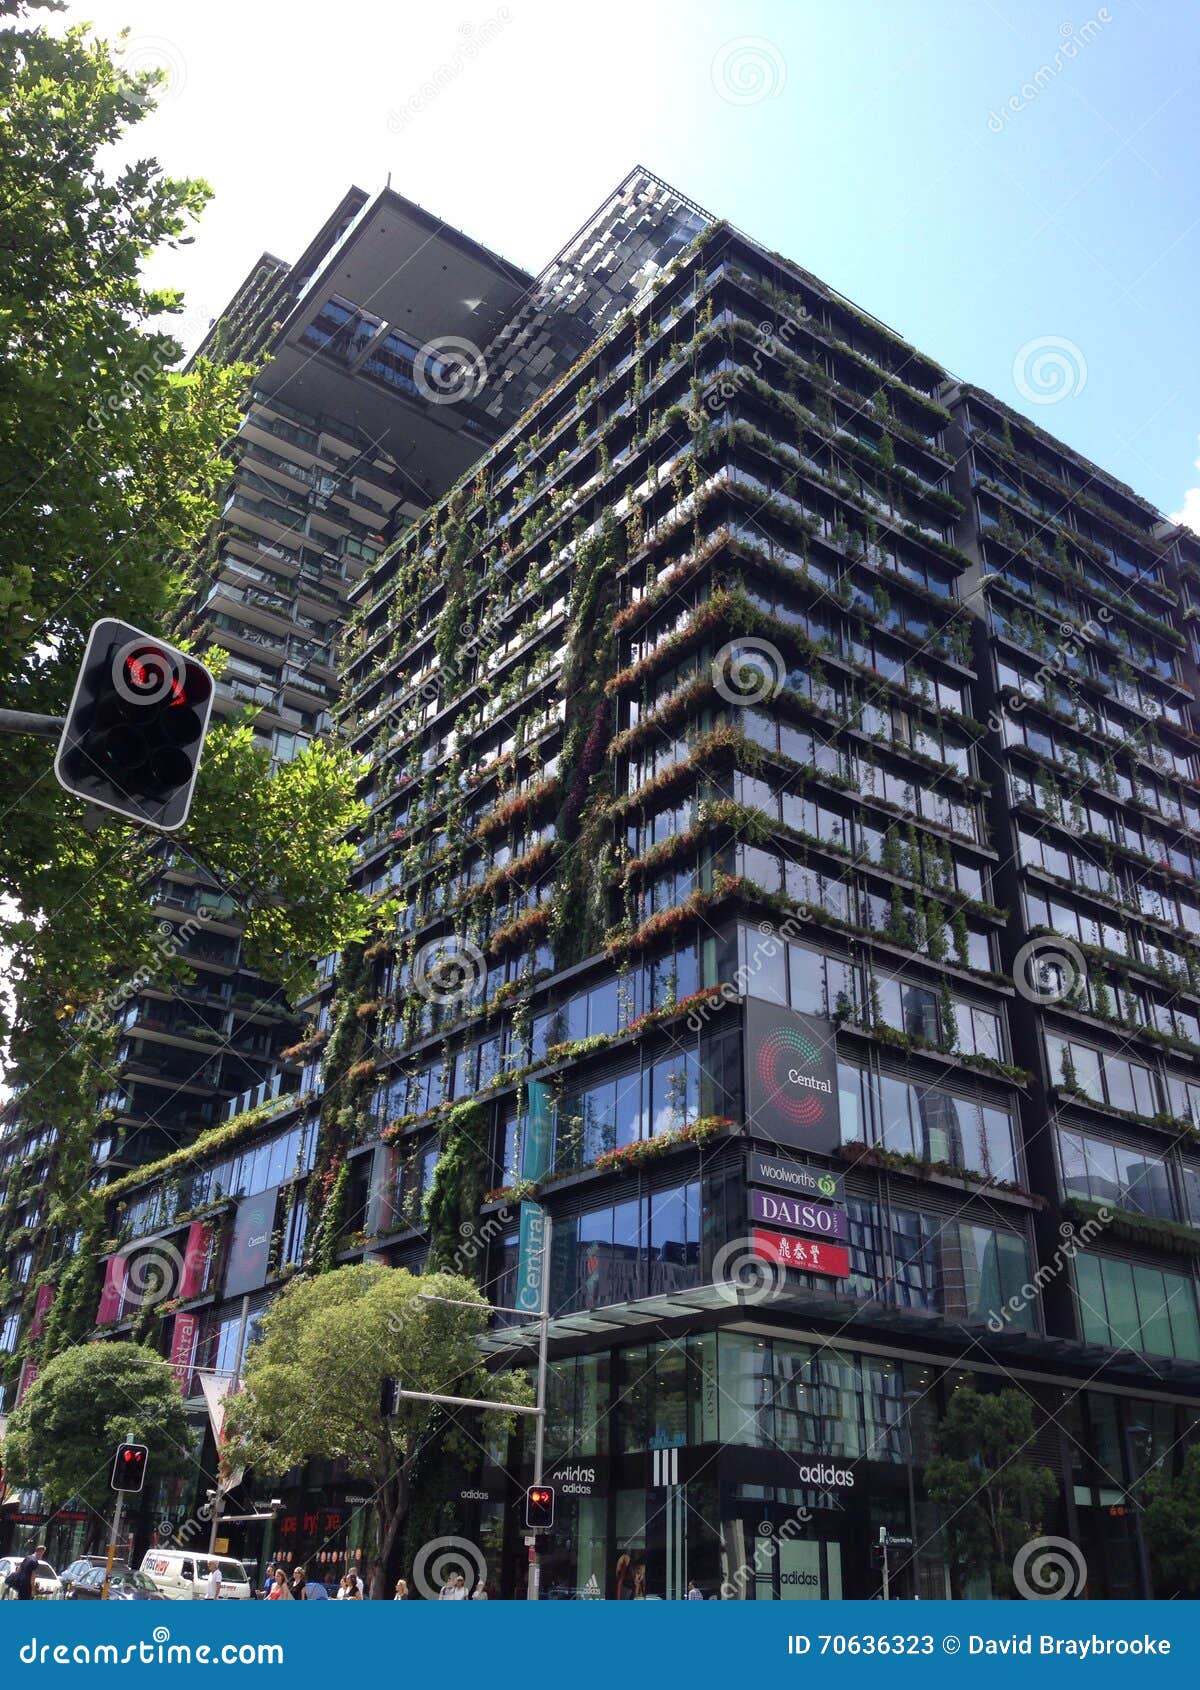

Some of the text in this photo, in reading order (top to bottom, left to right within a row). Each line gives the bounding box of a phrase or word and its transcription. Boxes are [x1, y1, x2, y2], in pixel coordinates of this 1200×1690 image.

[788, 1068, 832, 1094] Central
[761, 1196, 832, 1232] DAISO
[519, 1207, 546, 1310] Central
[175, 1317, 195, 1377] entral
[799, 1463, 855, 1487] adidas
[460, 1489, 489, 1500] adidas
[562, 1483, 592, 1495] adidas
[780, 1571, 819, 1586] adidas
